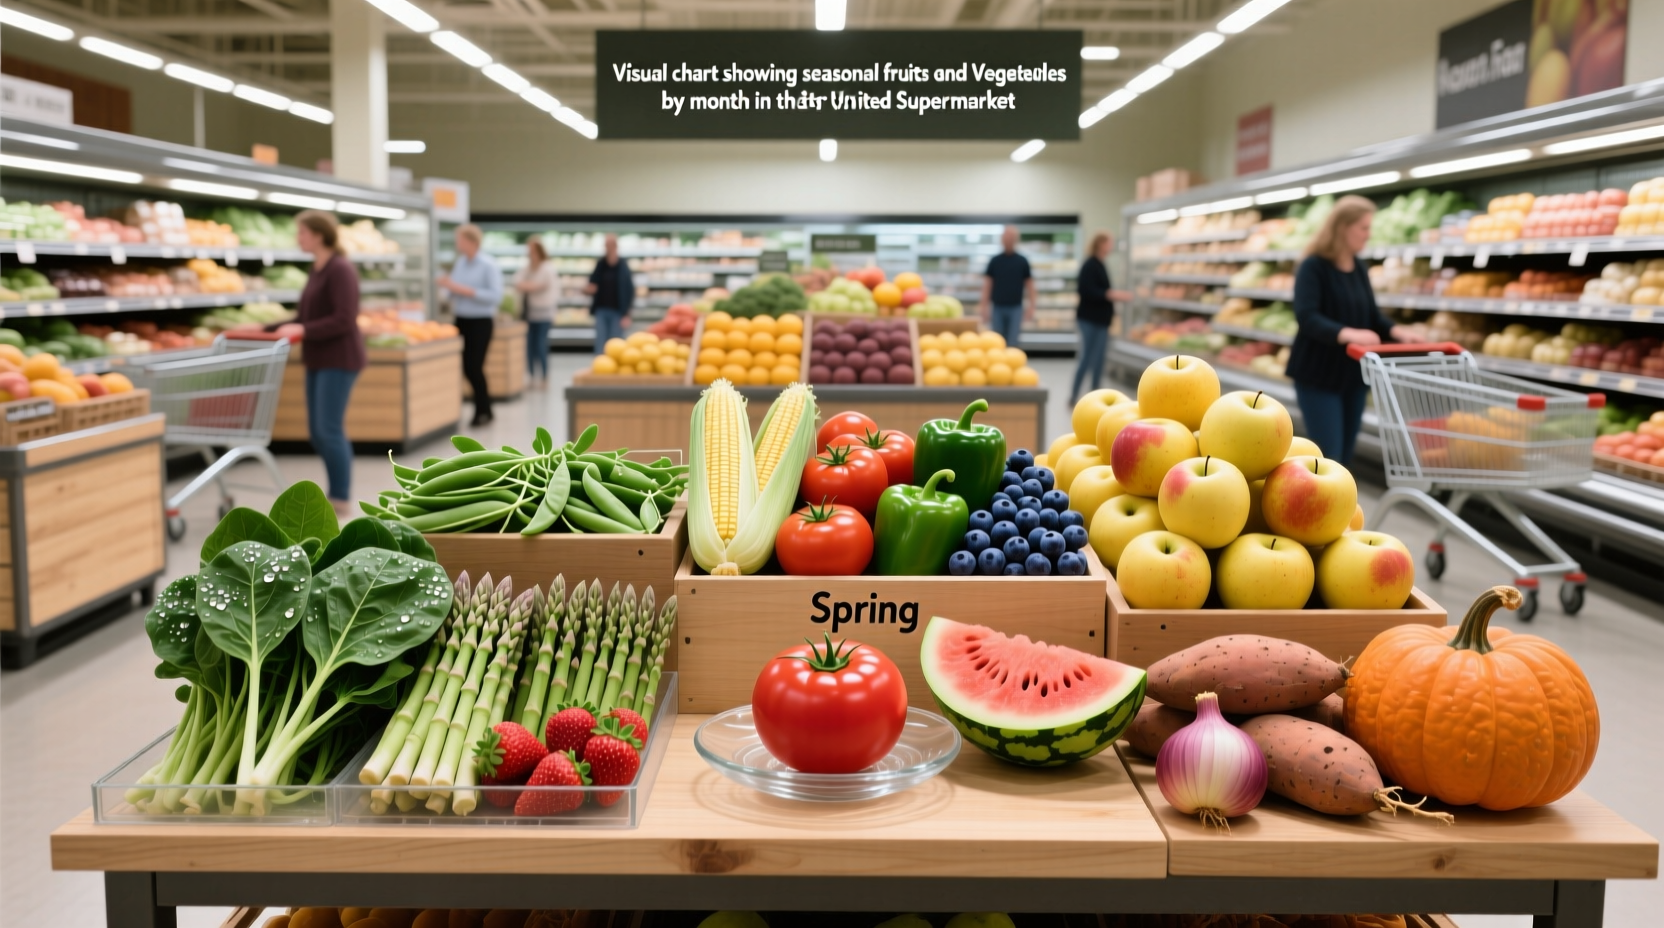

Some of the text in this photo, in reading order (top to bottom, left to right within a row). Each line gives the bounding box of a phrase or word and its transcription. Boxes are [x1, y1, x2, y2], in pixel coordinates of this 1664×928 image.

[612, 62, 668, 83] Visual
[671, 62, 720, 83] chart
[722, 62, 797, 88] showing
[802, 62, 880, 83] seasonal
[883, 61, 930, 83] fruits
[933, 62, 968, 82] and
[661, 89, 686, 117] by
[689, 89, 750, 110] month
[754, 90, 772, 110] in
[896, 89, 1016, 116] Supermarket
[810, 590, 919, 634] Spring
